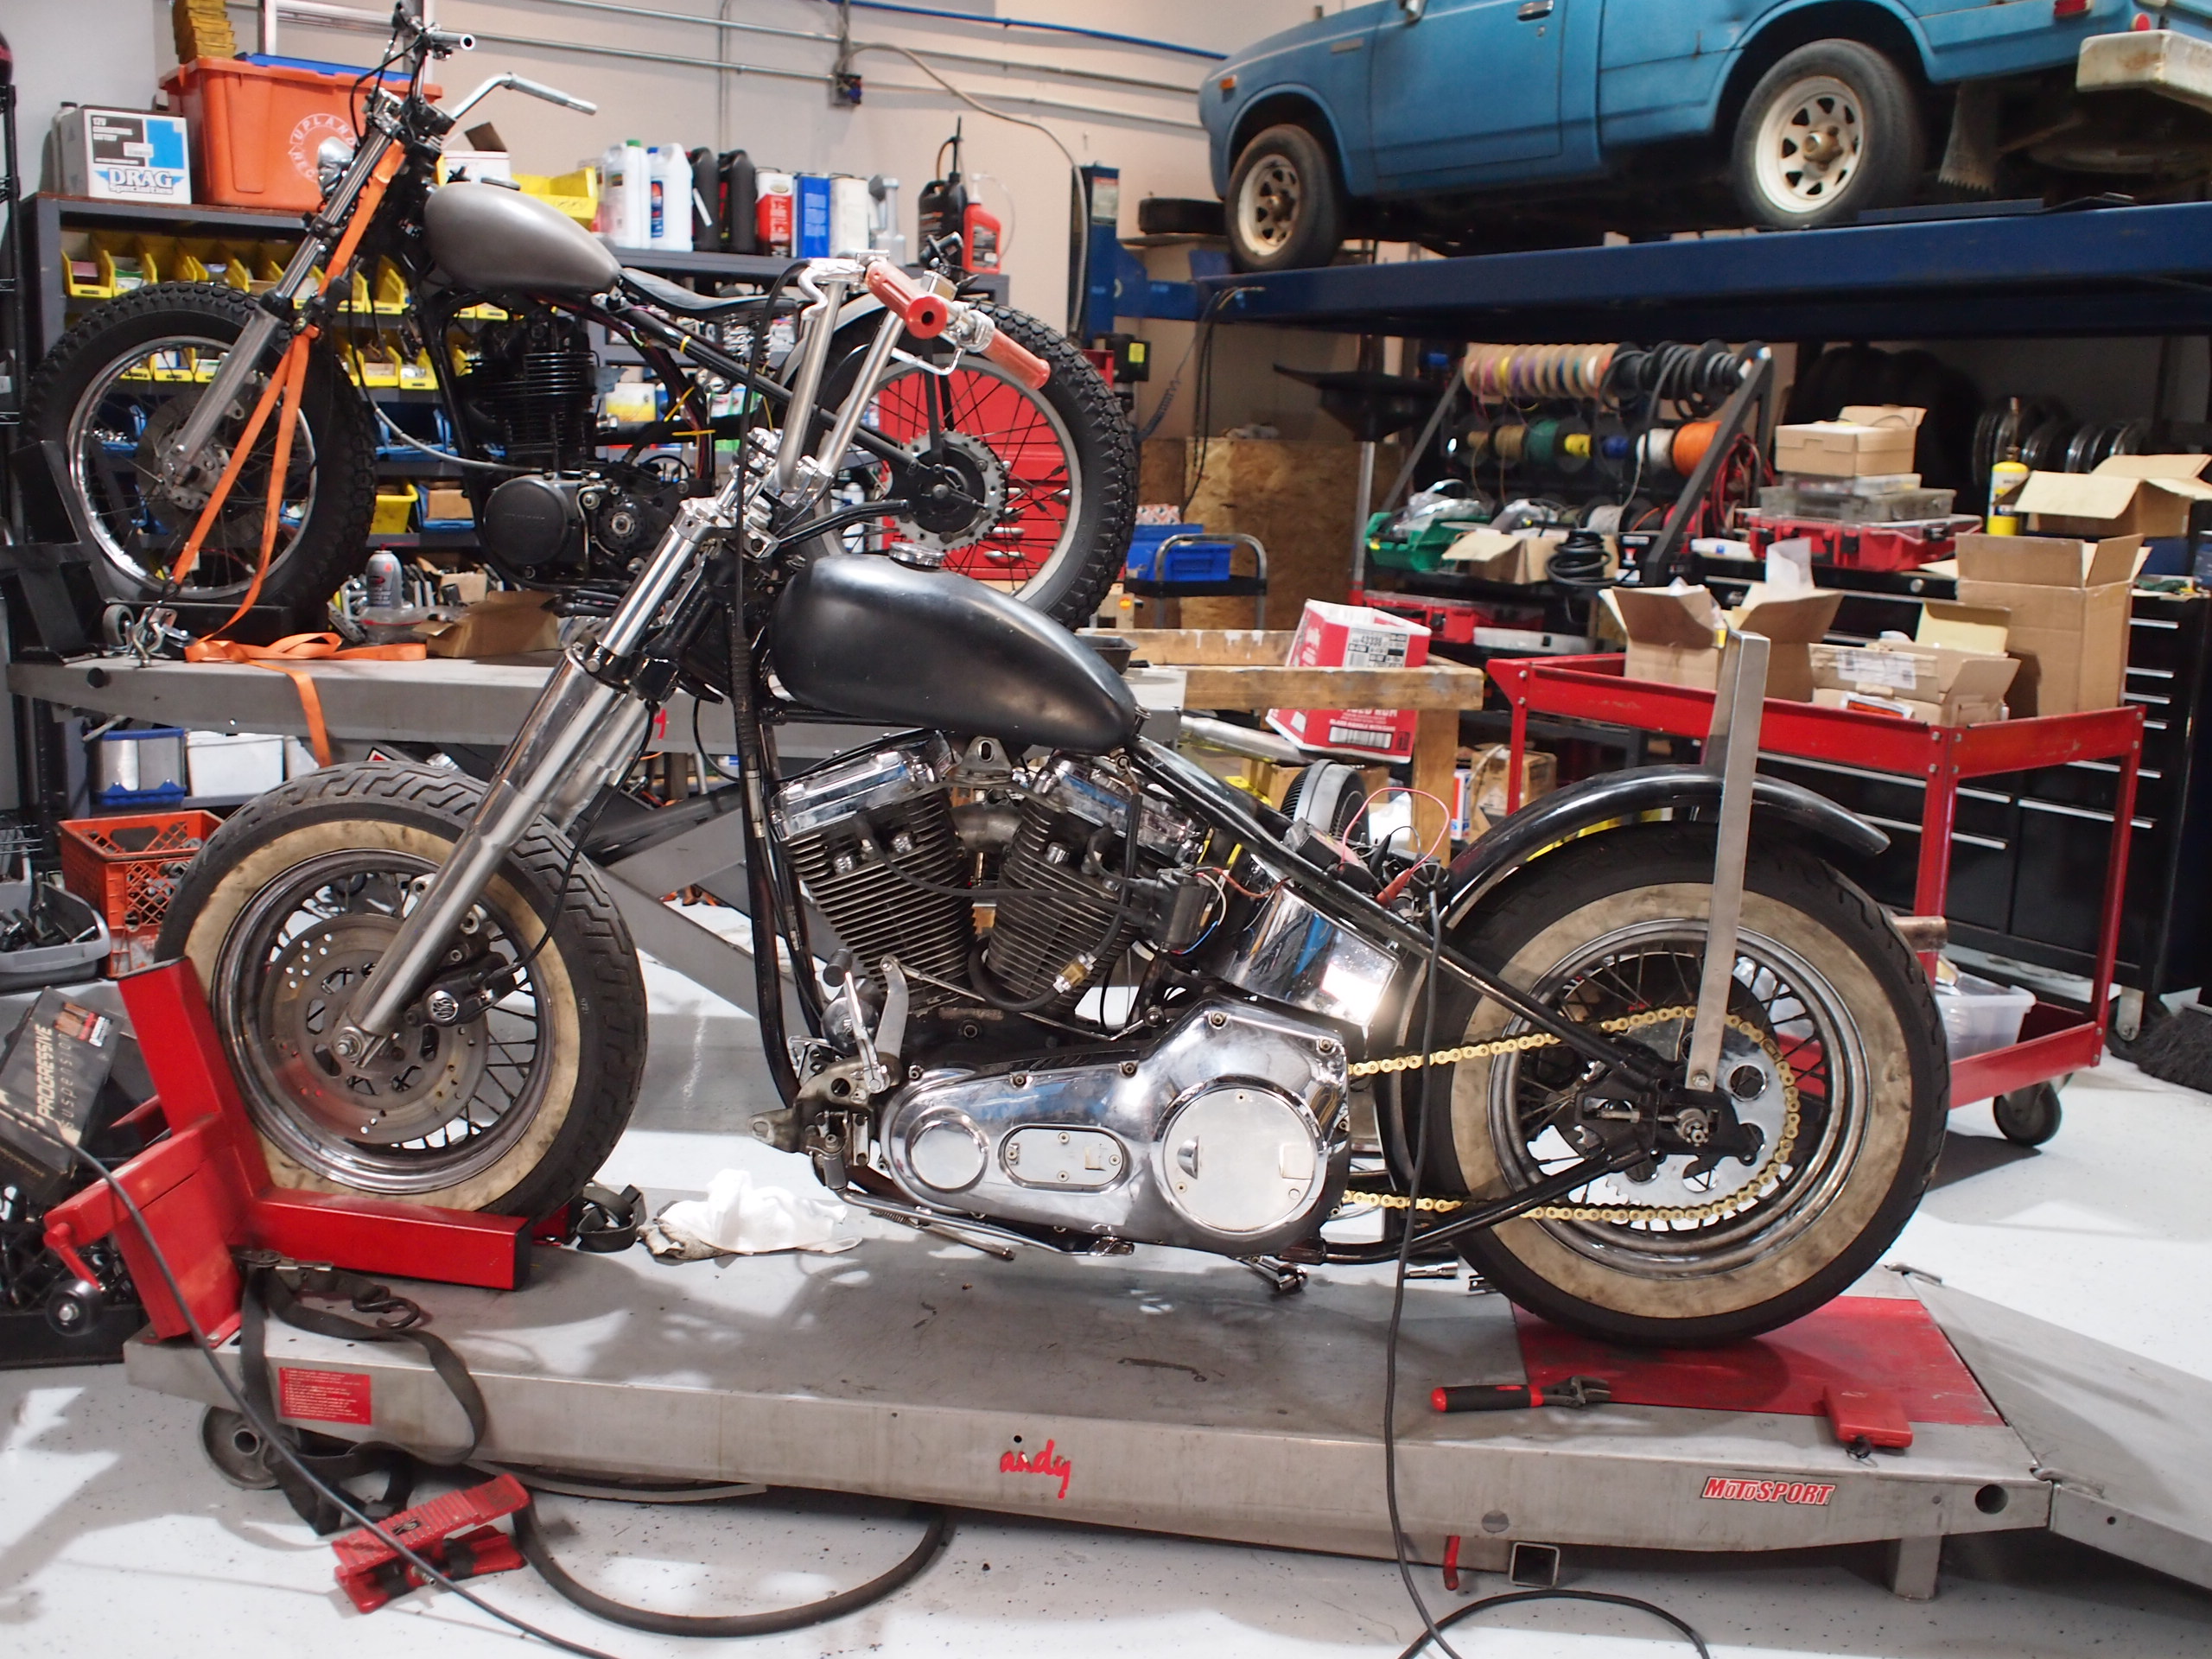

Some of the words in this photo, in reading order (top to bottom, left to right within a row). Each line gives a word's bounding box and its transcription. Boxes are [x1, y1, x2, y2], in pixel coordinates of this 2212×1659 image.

[294, 116, 357, 149] UPLAND
[108, 168, 173, 188] DRAG
[35, 1023, 56, 1122] PROGRESSIVE
[1702, 1476, 1836, 1506] MOTOSPORT
